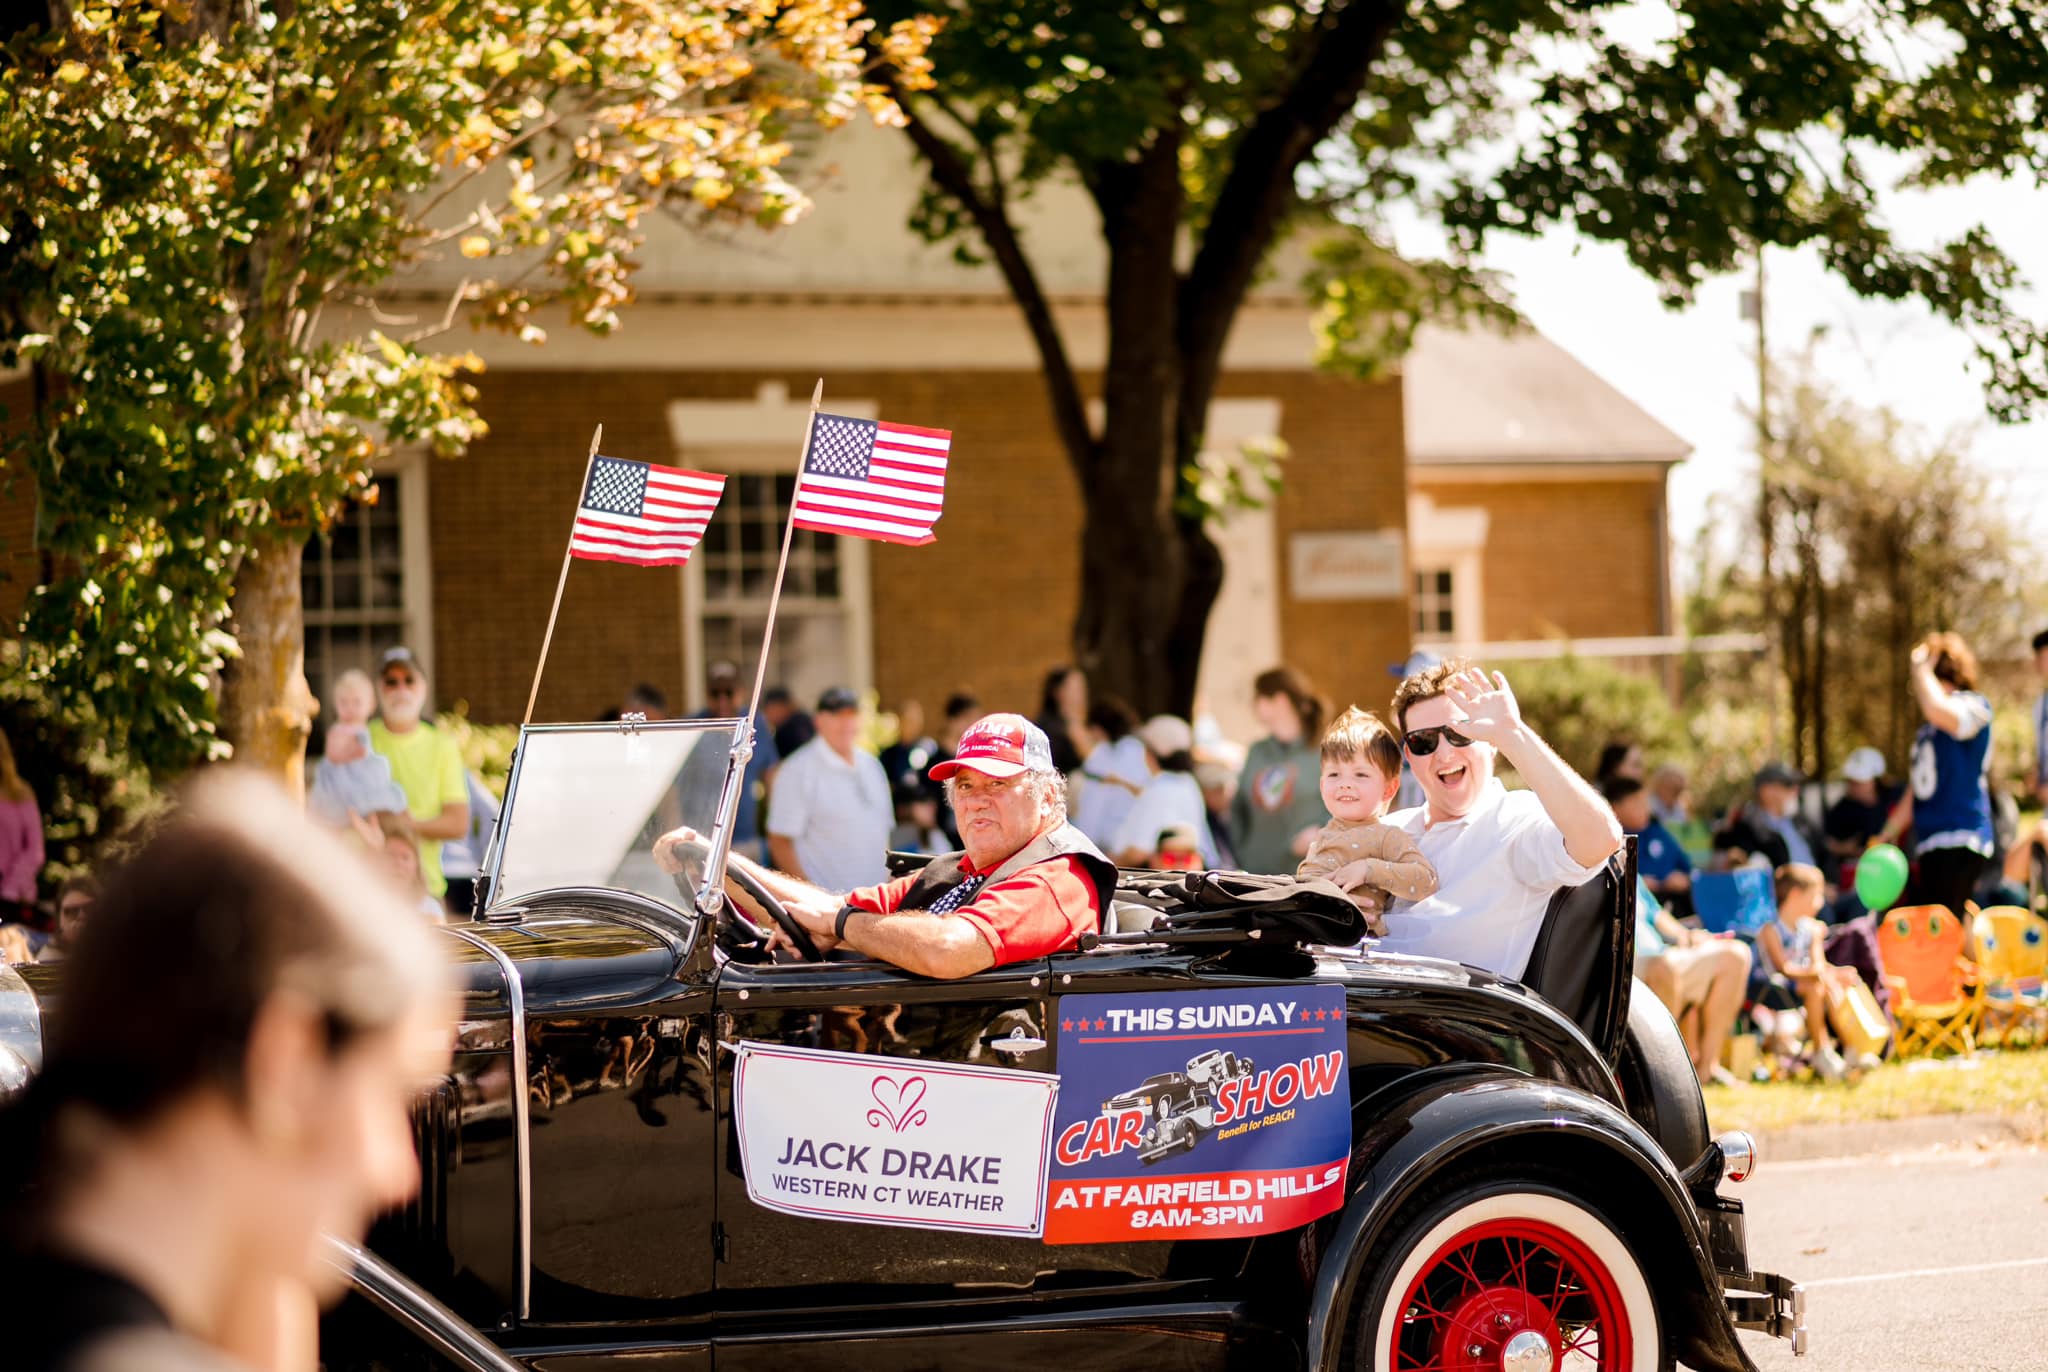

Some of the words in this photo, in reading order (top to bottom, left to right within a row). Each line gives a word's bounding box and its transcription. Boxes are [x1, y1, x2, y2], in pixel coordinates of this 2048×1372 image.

[961, 720, 1014, 740] TRUMP
[1106, 1008, 1174, 1032] THIS
[1178, 1002, 1297, 1028] SUNDAY
[1056, 1109, 1145, 1166] CAR
[1213, 1050, 1344, 1125] SHOW
[1217, 1123, 1249, 1140] Benefit
[1249, 1119, 1262, 1131] for
[1262, 1108, 1296, 1127] REACH
[777, 1137, 871, 1174] JACK
[881, 1148, 1002, 1185] DRAKE
[772, 1173, 867, 1200] WESTERN
[873, 1185, 901, 1203] CT
[907, 1189, 1004, 1212] WEATHER
[1054, 1186, 1100, 1209] AT
[1103, 1178, 1252, 1207] FAIRFIELD
[1257, 1166, 1341, 1199] HILLS
[1130, 1205, 1263, 1229] 8AM-3PM
